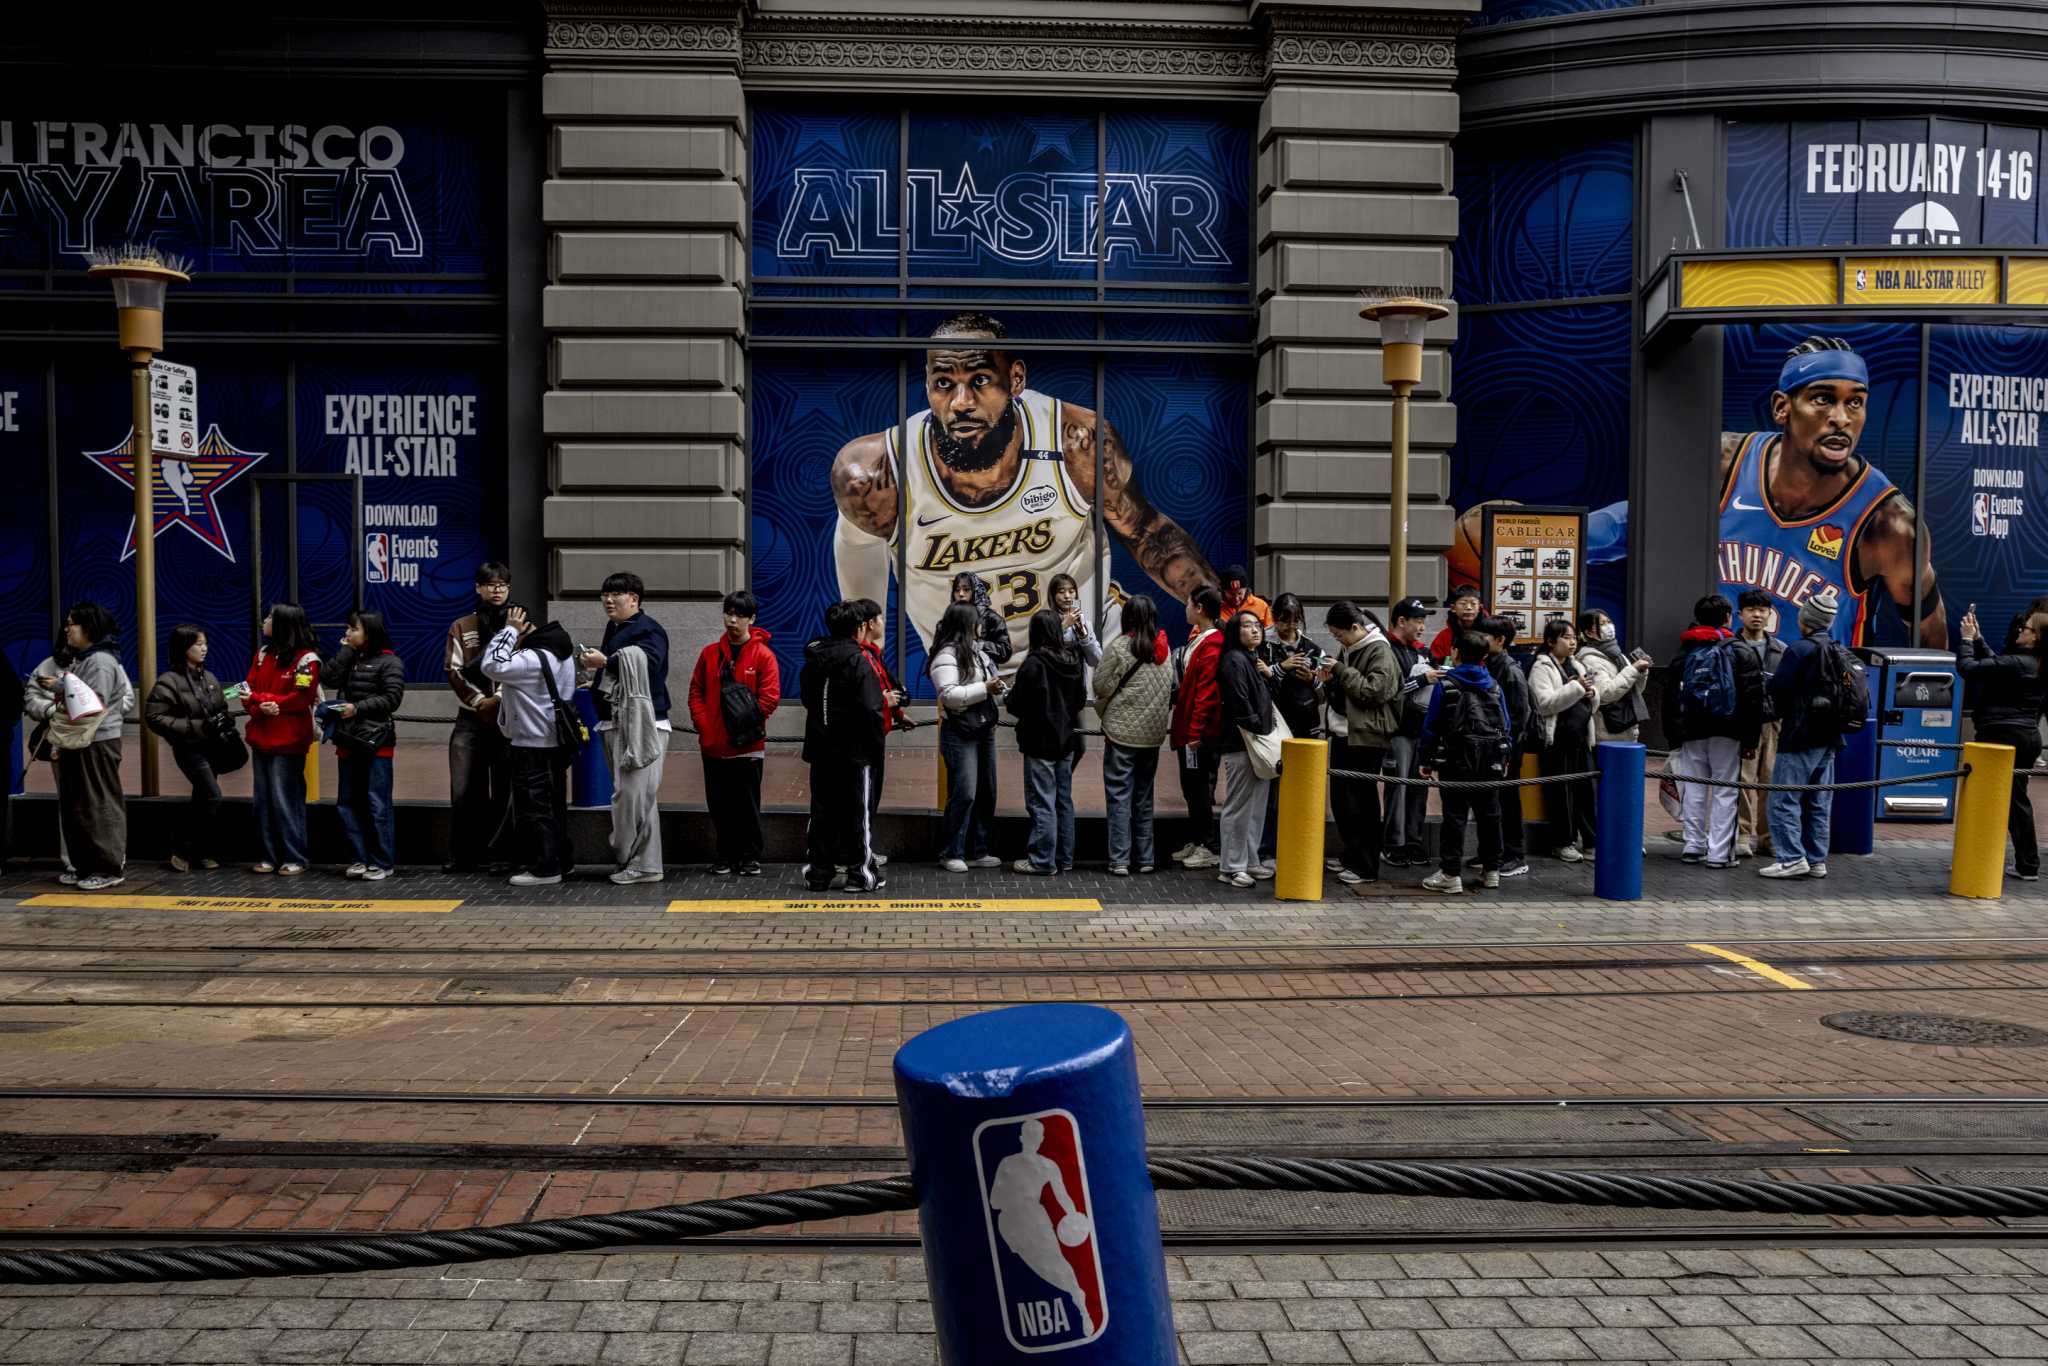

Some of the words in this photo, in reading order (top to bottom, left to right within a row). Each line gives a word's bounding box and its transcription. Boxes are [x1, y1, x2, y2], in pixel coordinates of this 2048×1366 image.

[33, 121, 405, 169] FRANCISCO
[1807, 143, 1967, 194] FEBRUARY
[1976, 147, 2033, 201] 14-16
[126, 165, 423, 257] AREA
[1875, 270, 1900, 289] NBA
[1956, 270, 1986, 289] ALLEY
[325, 394, 477, 435] EXPERIENCE
[1973, 468, 2024, 488] DOWNLOAD
[1024, 491, 1056, 506] bibigo
[1991, 494, 2024, 515] Events
[365, 504, 438, 527] DOWNLOAD
[1989, 515, 2009, 539] App
[1496, 526, 1541, 537] CABLE
[1545, 527, 1575, 537] CAR
[391, 534, 439, 558] Events
[914, 518, 1056, 571] LAKERS
[391, 558, 419, 587] App
[1896, 746, 1941, 758] SQUARE
[1017, 1297, 1071, 1338] NBA
